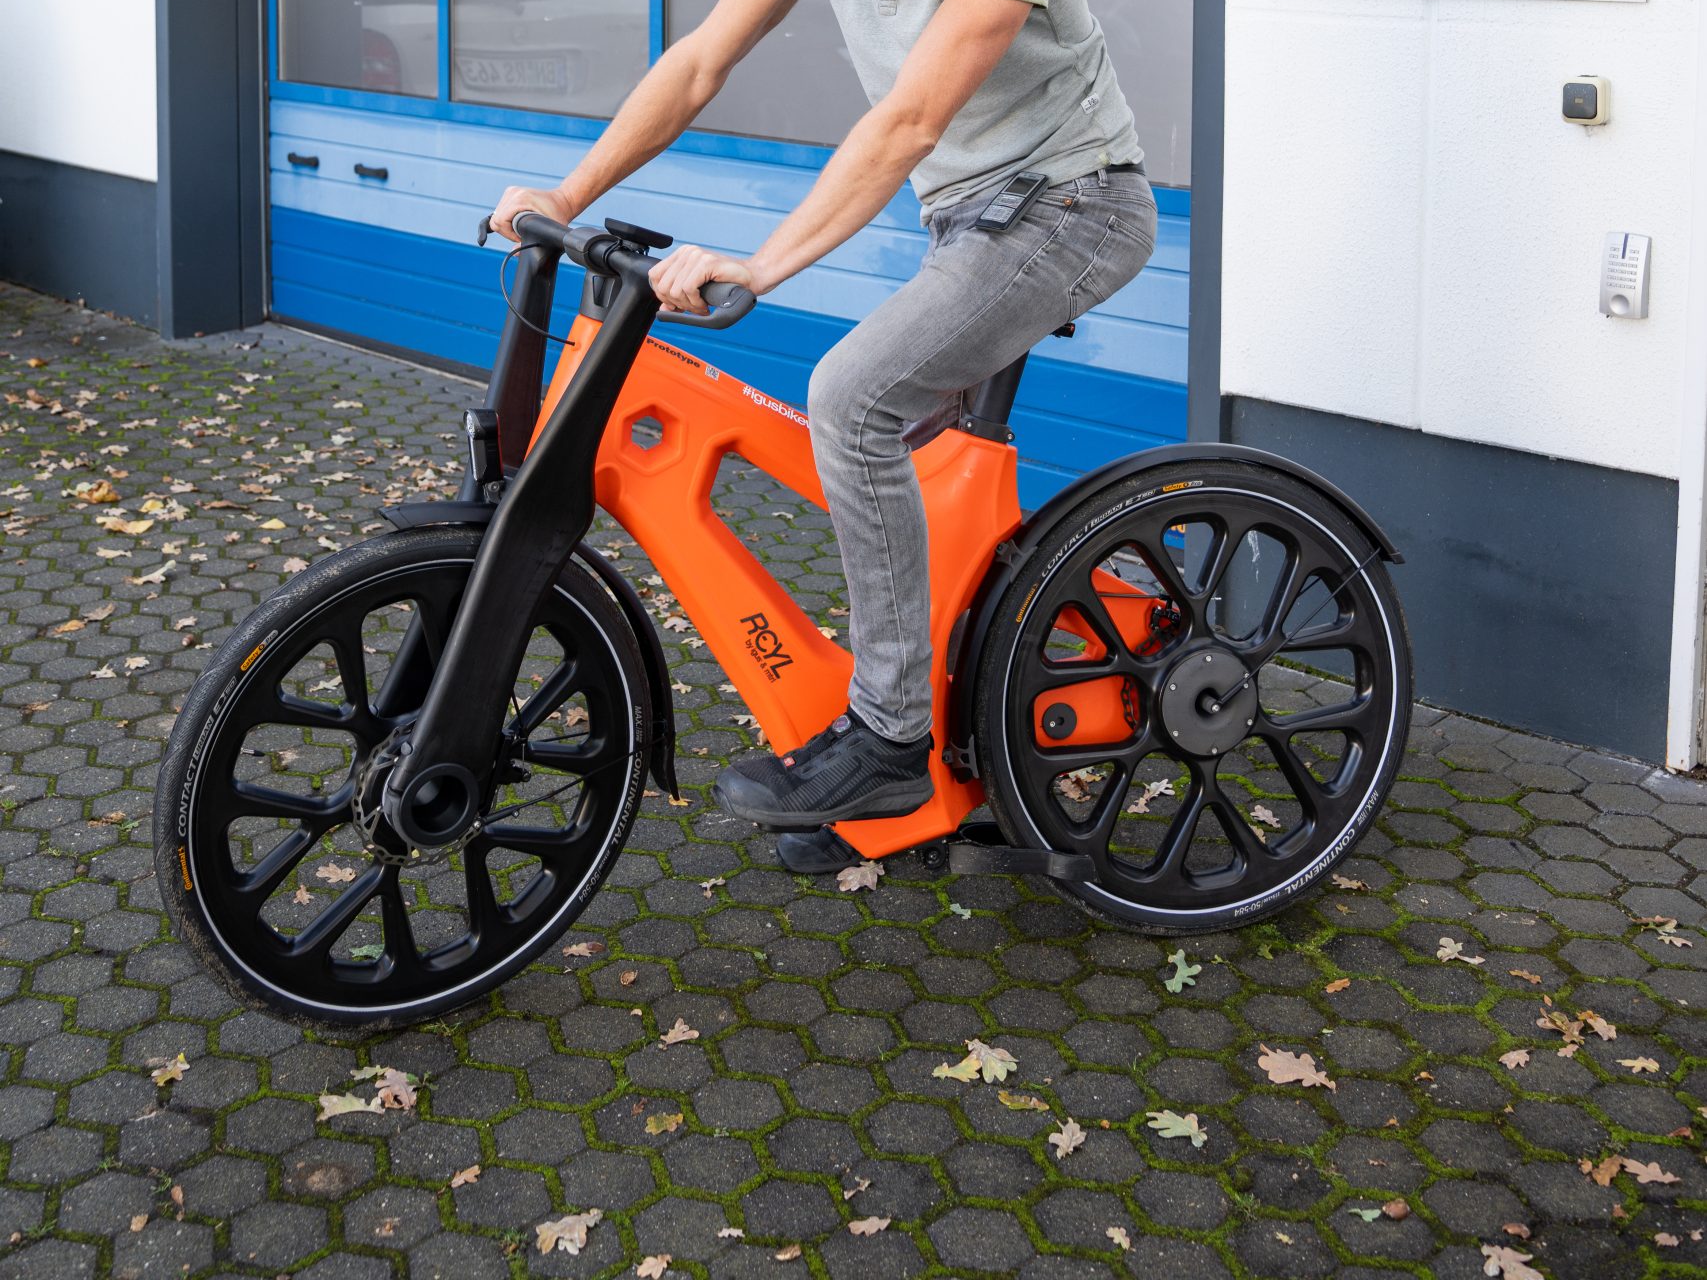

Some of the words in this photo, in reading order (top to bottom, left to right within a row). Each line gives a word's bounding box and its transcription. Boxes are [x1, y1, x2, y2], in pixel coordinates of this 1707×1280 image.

[646, 338, 701, 368] Prototype
[1042, 523, 1090, 577] CONTACT
[178, 761, 197, 838] CONTACT
[611, 751, 643, 846] CONTINENTAL
[1284, 828, 1356, 895] CONTINENTAL
